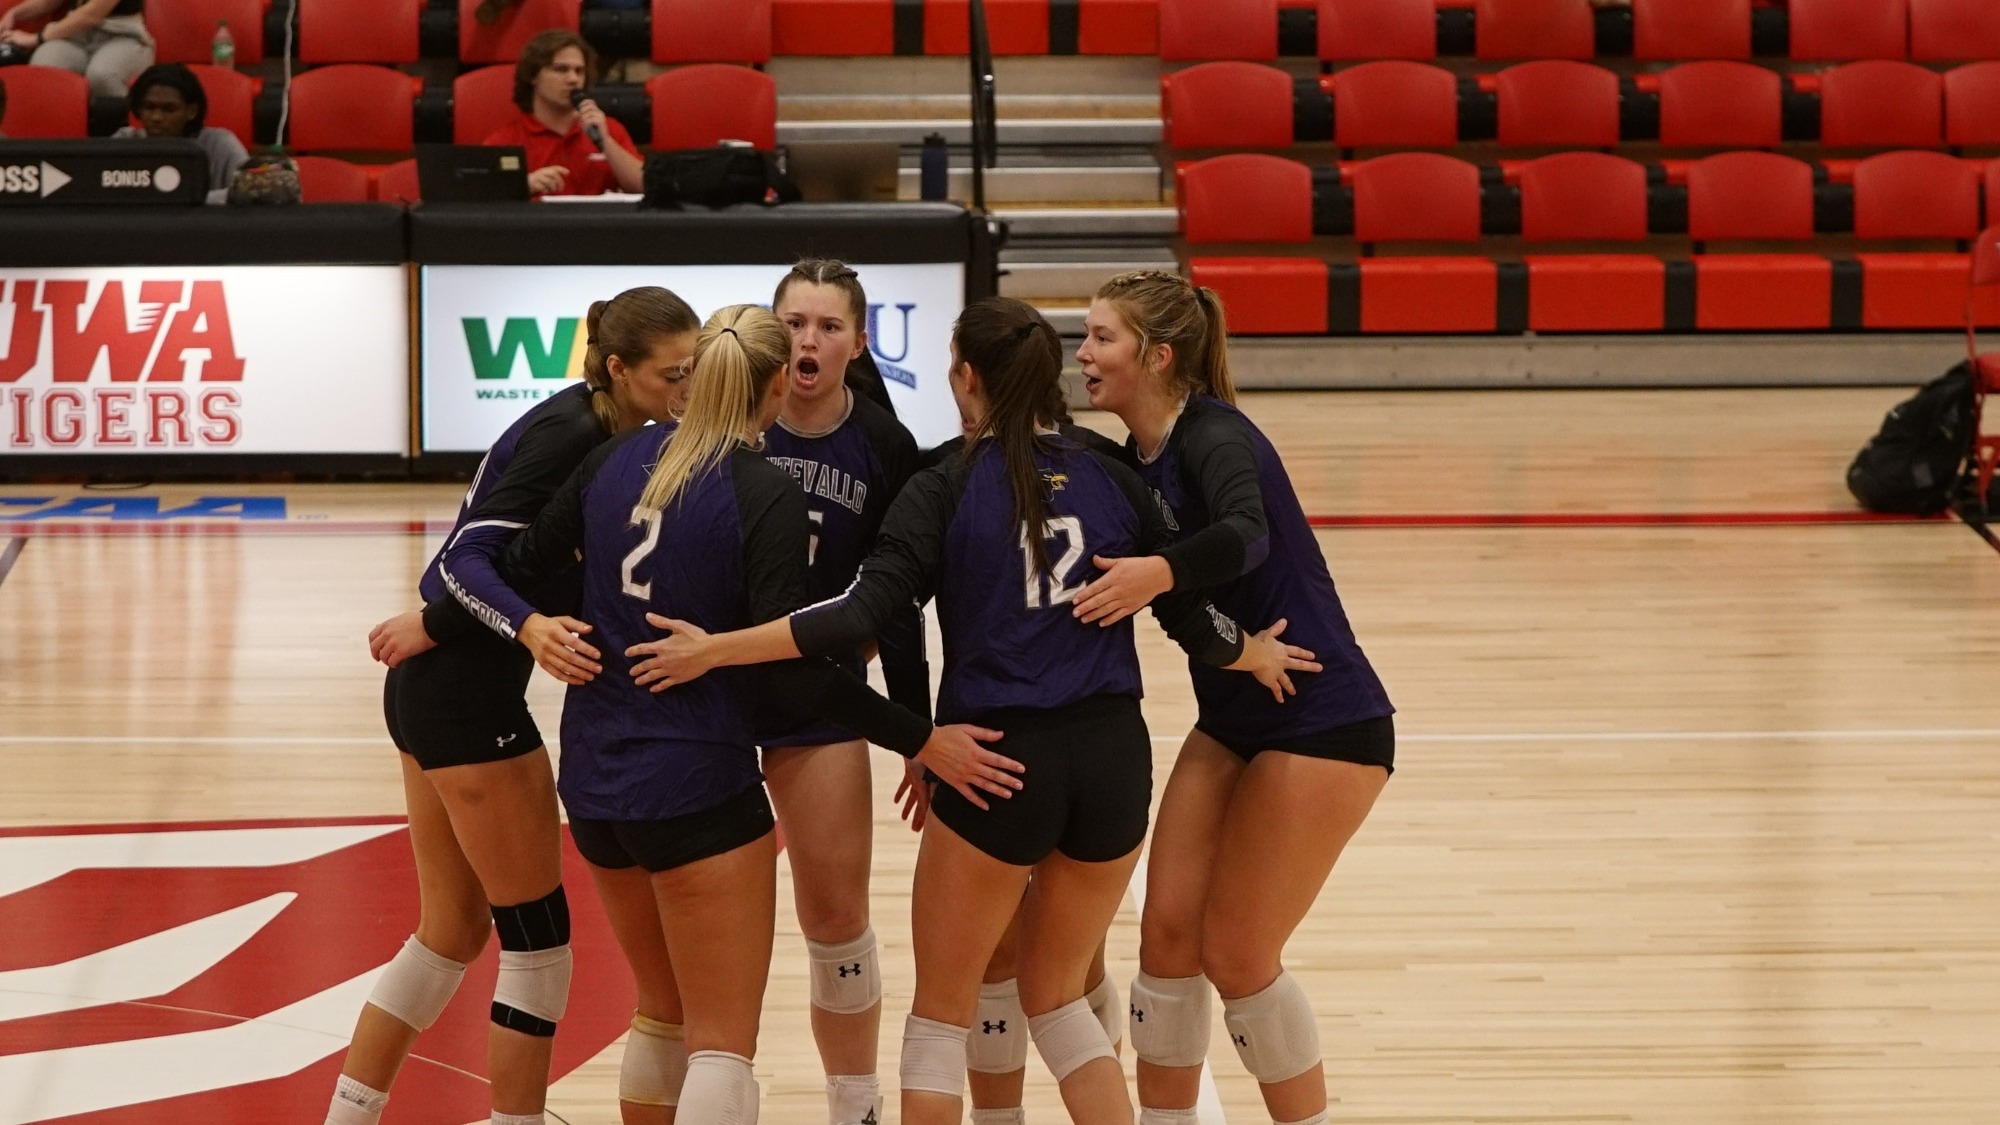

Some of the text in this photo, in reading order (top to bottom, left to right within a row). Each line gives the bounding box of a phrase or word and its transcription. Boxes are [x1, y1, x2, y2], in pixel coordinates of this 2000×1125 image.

[0, 165, 40, 193] SS
[101, 169, 151, 188] BONUS
[475, 388, 541, 400] WASTE
[0, 387, 243, 447] IGERS
[621, 504, 663, 603] 2
[1018, 514, 1088, 610] 12
